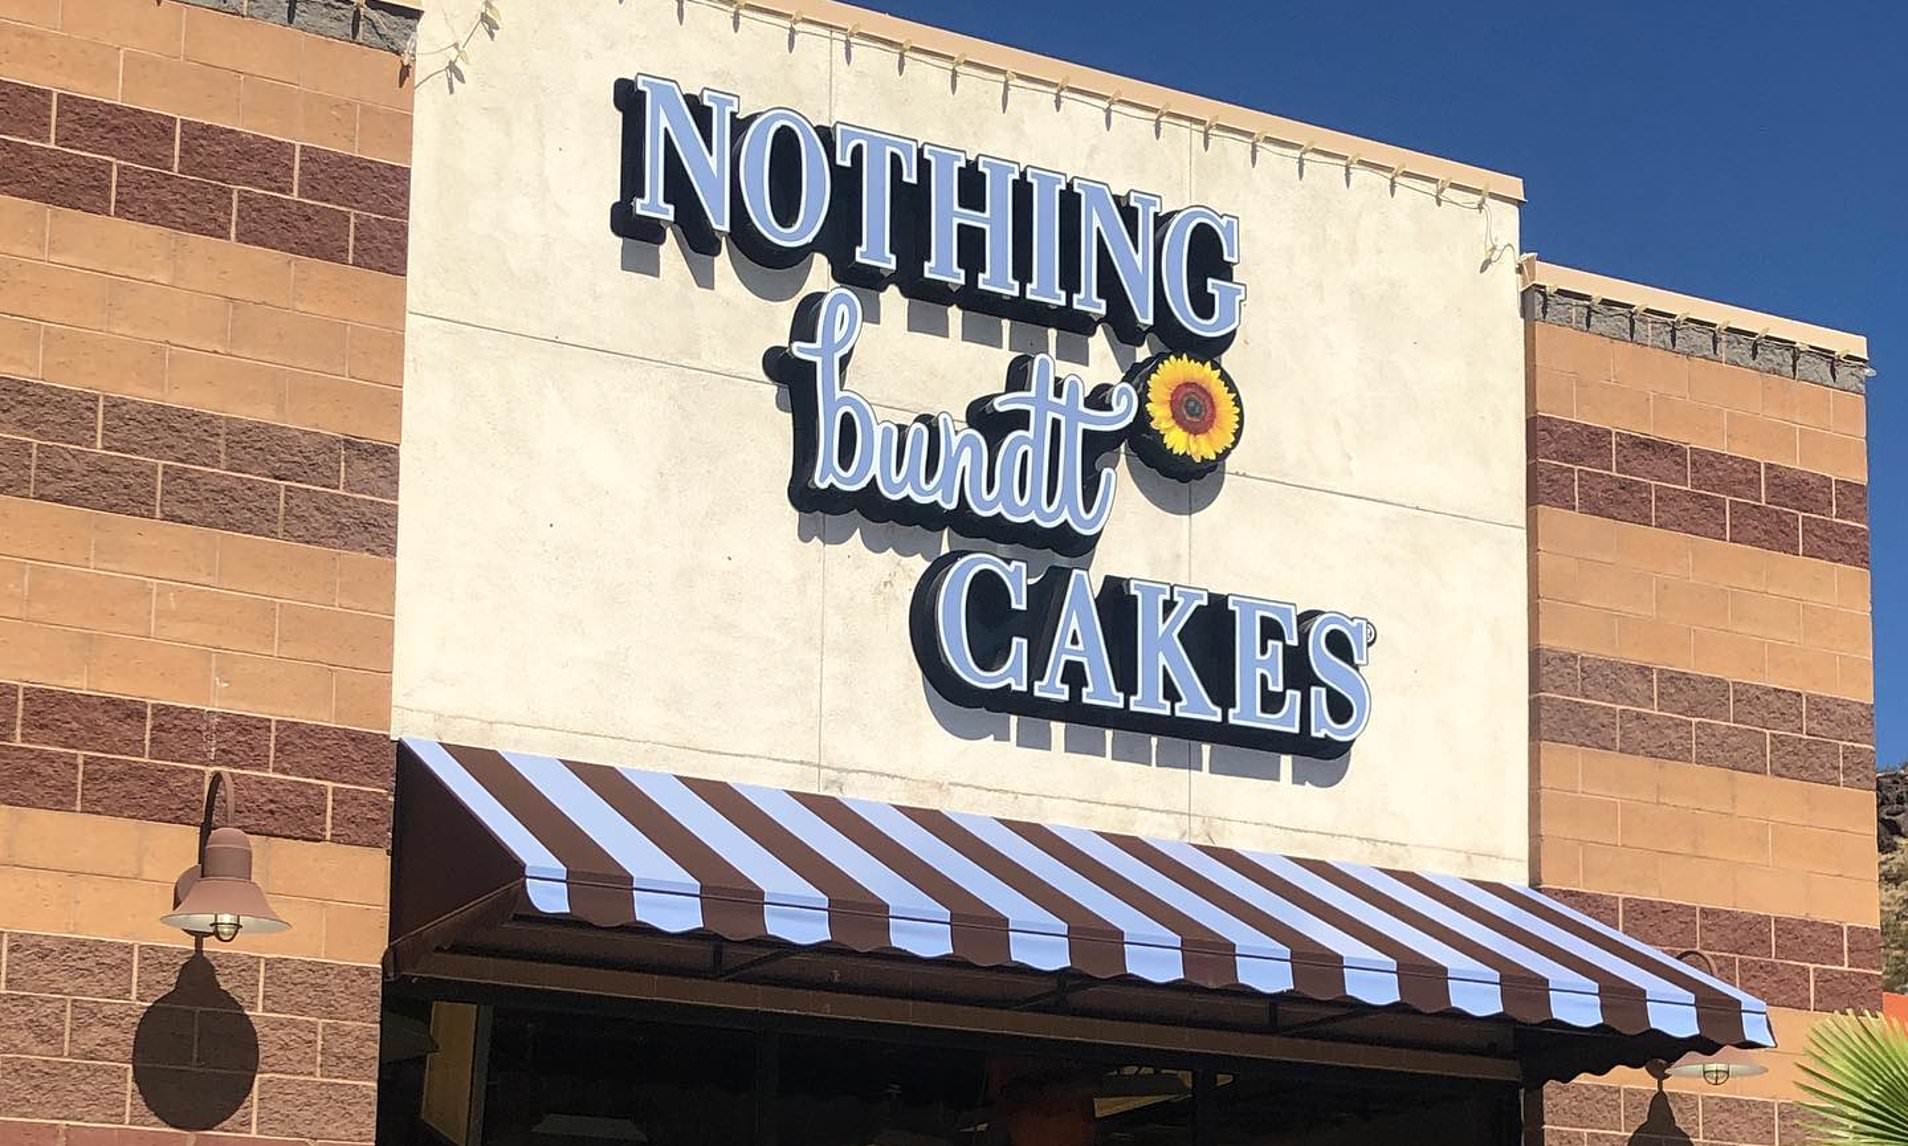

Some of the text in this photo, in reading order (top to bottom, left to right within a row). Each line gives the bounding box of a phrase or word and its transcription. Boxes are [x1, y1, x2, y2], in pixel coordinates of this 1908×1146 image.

[634, 75, 1246, 338] NOTHING
[791, 288, 1138, 535] bundt
[936, 553, 1371, 740] CAKES
